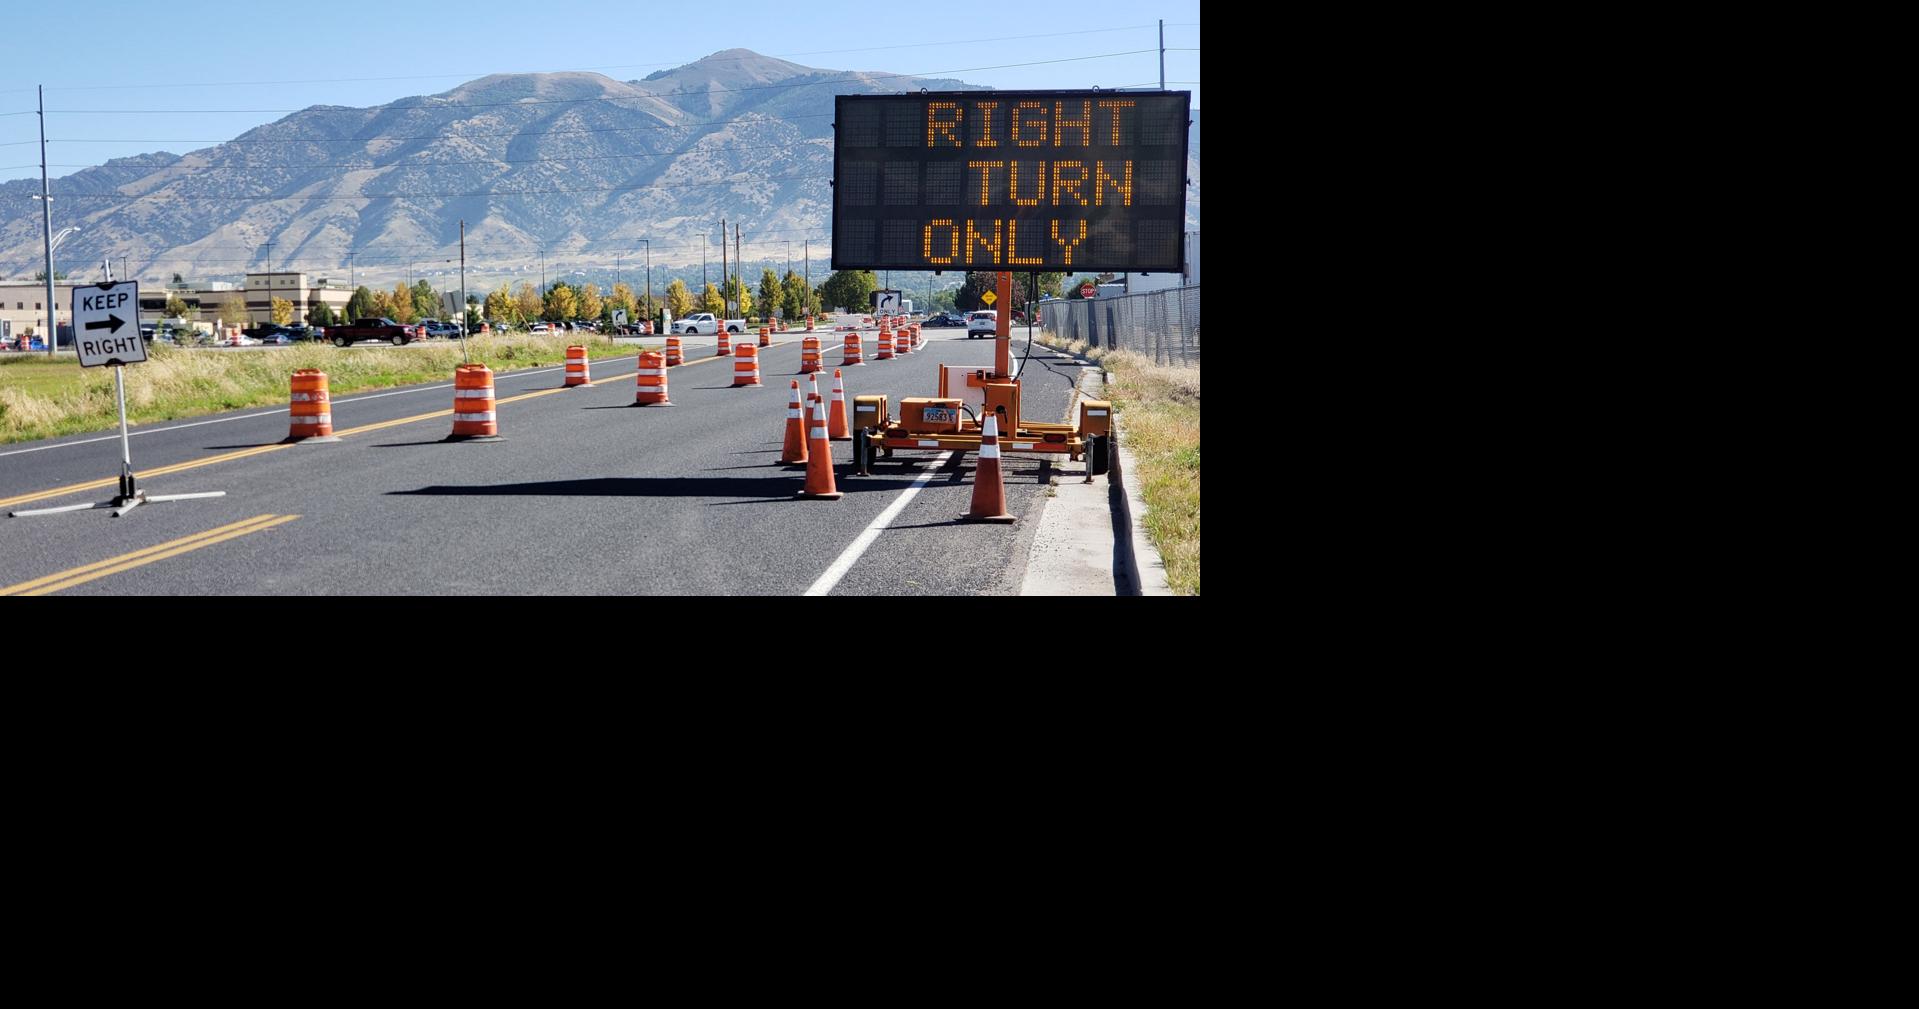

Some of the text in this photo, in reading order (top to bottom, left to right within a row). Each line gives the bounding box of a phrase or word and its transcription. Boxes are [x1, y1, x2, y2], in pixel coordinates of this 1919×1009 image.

[927, 100, 1136, 148] RIGHT
[969, 160, 1132, 206] TURN
[923, 219, 1087, 265] ONLY
[83, 293, 128, 311] KEEP
[83, 337, 136, 356] RIGHT
